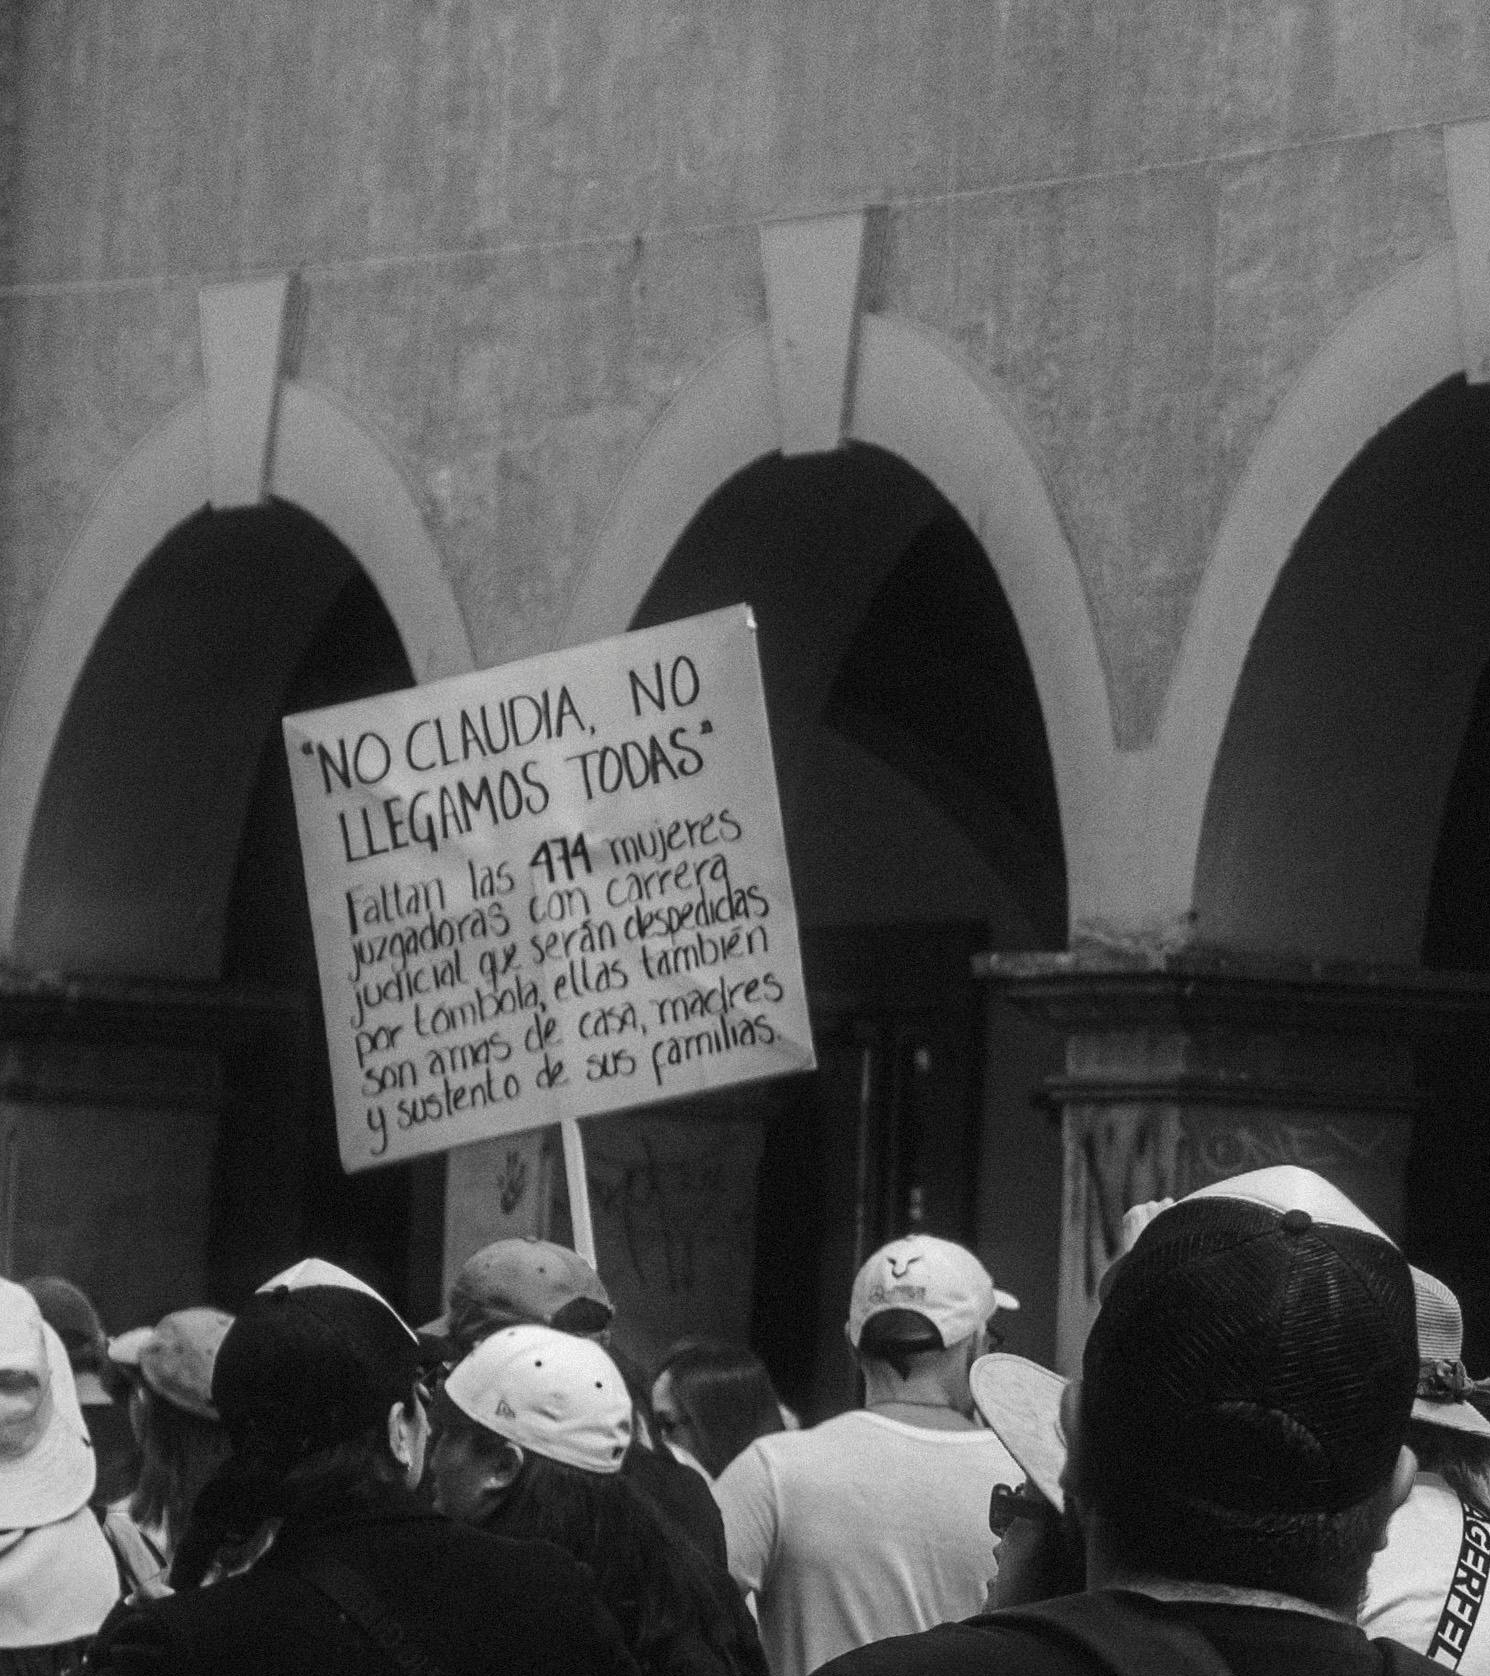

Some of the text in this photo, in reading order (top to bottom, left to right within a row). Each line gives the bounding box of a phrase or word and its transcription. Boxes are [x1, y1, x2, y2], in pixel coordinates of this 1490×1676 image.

[406, 686, 595, 771] CLAUDIA,
[629, 655, 700, 716] NO
[339, 761, 549, 862] LLEGAMOS
[345, 809, 742, 935] Faltan las 474 mujeres
[348, 853, 728, 983] juzgadoras con carrera
[350, 949, 468, 1029] judicial
[530, 919, 616, 964] serán
[624, 885, 769, 945] despedidas
[355, 1026, 402, 1068] por
[554, 957, 629, 1000] ellas
[362, 1061, 417, 1096] son
[430, 1032, 512, 1075] amas
[525, 1013, 563, 1052] de
[652, 972, 784, 1024] madres
[367, 1107, 388, 1156] y
[397, 1067, 519, 1130] sustento
[536, 1052, 569, 1088] de
[586, 1049, 636, 1081] sus
